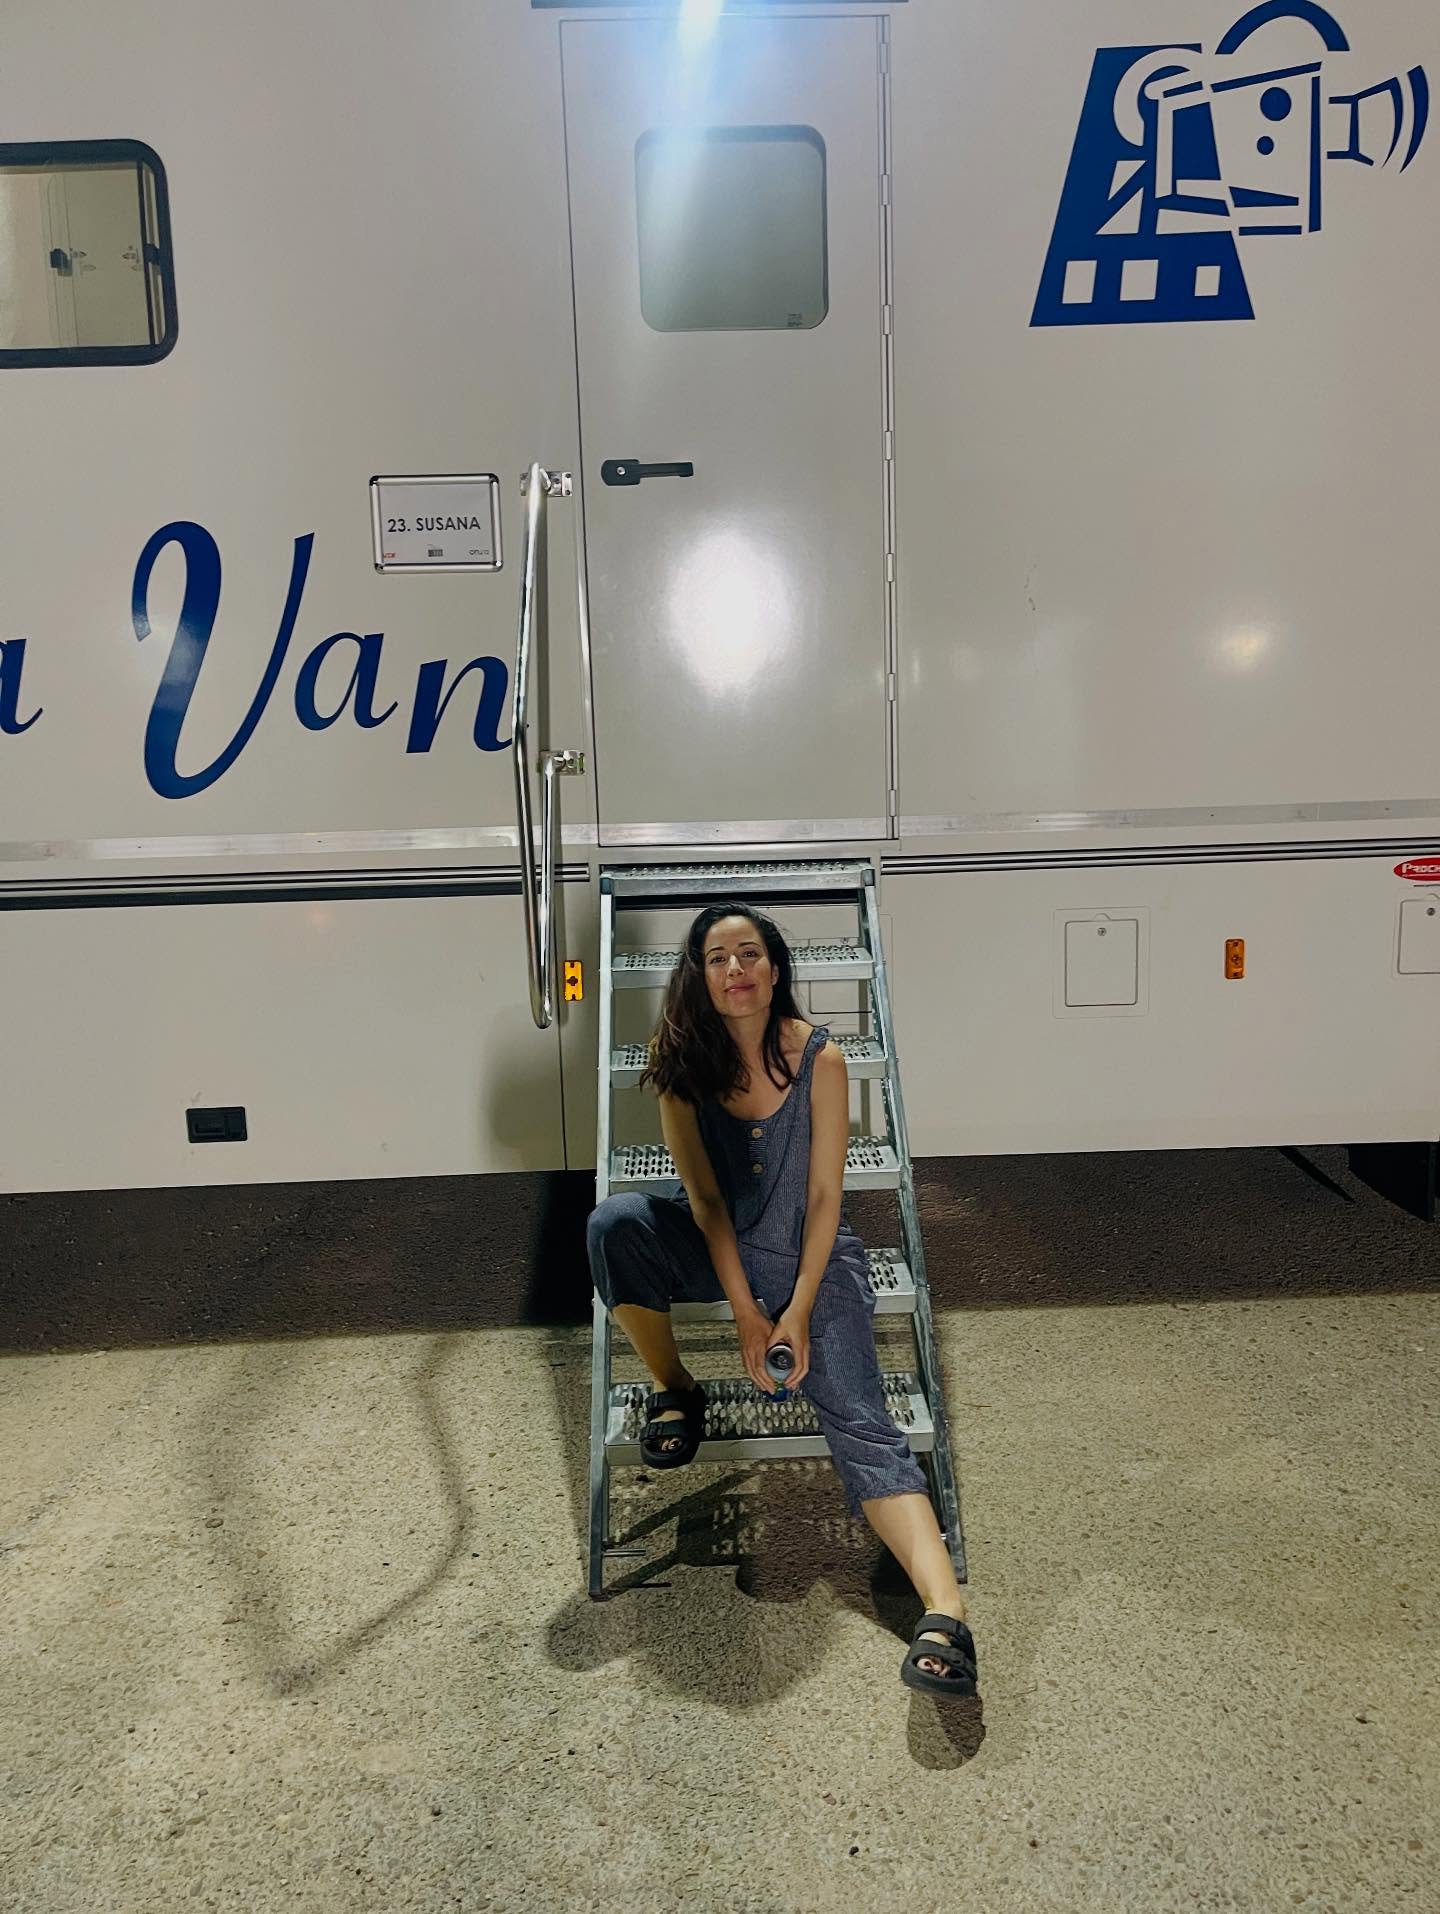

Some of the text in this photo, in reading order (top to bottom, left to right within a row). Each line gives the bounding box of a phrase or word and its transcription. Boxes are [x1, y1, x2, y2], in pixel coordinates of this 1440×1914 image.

[387, 516, 482, 533] 23. SUSANA
[131, 520, 514, 799] Van
